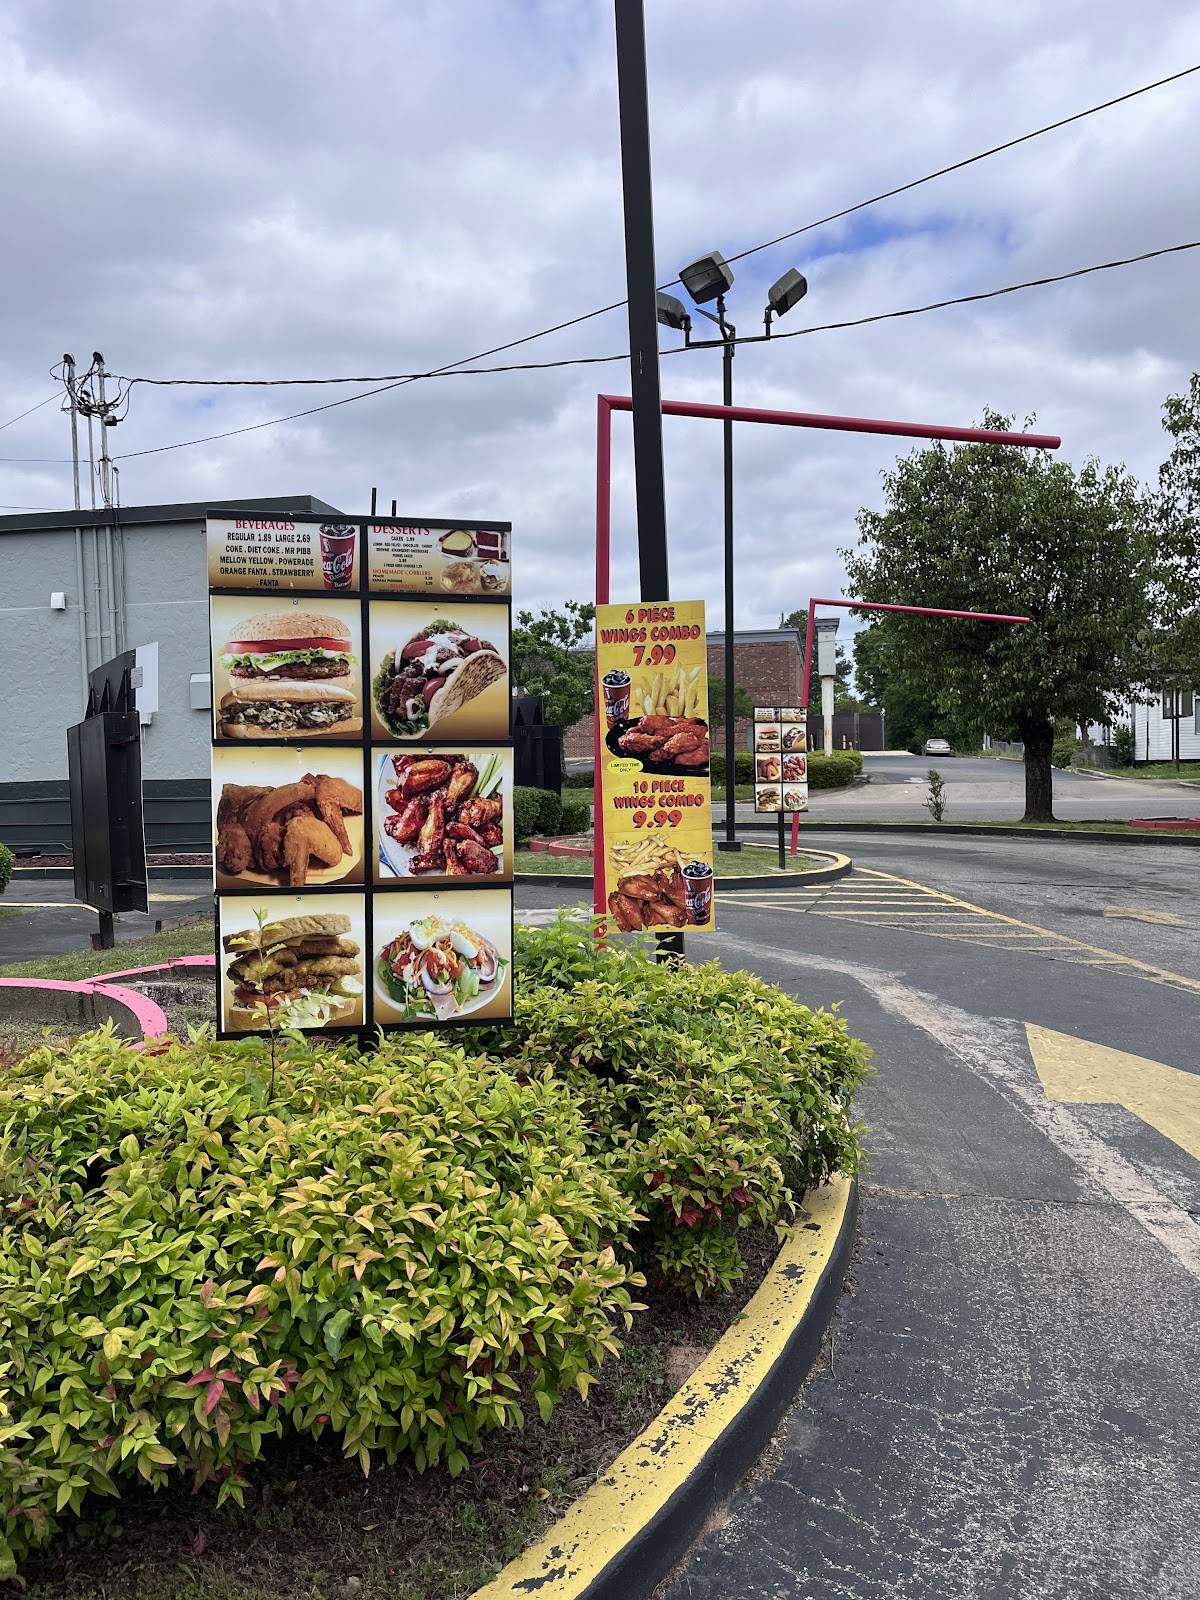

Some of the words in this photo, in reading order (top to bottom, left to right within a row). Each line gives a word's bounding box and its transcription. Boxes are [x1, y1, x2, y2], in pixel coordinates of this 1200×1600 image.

[235, 520, 295, 530] BEVERAGES
[373, 526, 430, 536] DESSERTS
[227, 532, 254, 541] REGULAR
[258, 534, 272, 542] 1.89
[275, 534, 295, 542] LARGE
[297, 534, 311, 543] 2.69
[625, 610, 634, 624] 6
[638, 607, 675, 623] PIECE
[600, 628, 646, 644] WINGS
[650, 625, 700, 642] COMBO
[633, 644, 676, 666] 7.99
[634, 781, 648, 793] 10
[652, 779, 685, 793] PIECE
[613, 795, 655, 809] WINGS
[659, 794, 704, 807] COMBO
[633, 810, 683, 829] 9.99
